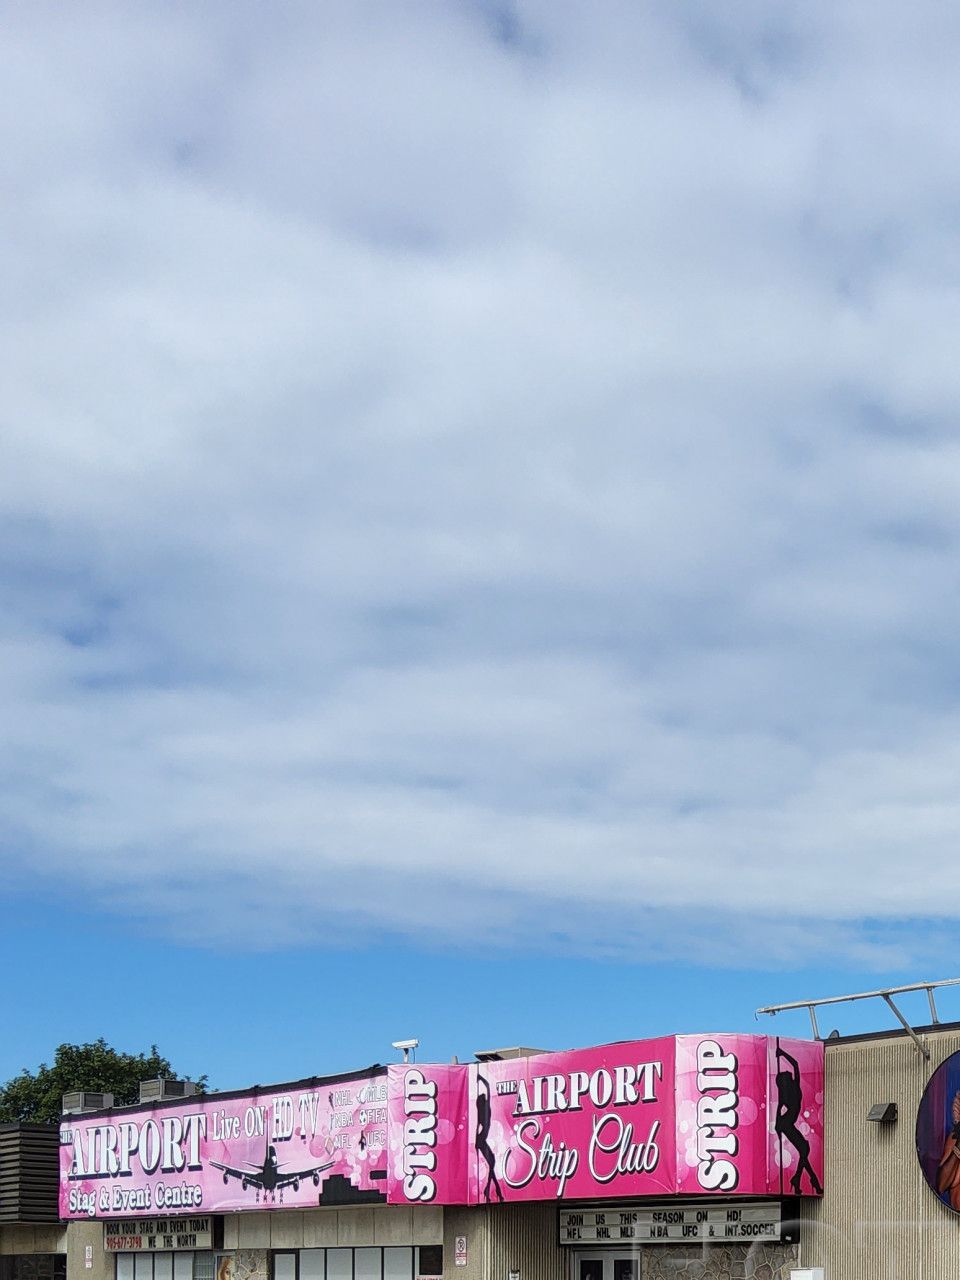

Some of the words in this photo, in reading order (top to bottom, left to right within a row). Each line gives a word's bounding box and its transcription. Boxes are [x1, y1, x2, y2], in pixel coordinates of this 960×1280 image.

[335, 1090, 353, 1107] NHL
[366, 1085, 387, 1103] MLB
[496, 1080, 517, 1096] THE
[512, 1061, 663, 1118] AIRPORT
[212, 1109, 240, 1141] Live
[244, 1105, 266, 1137] ON
[272, 1096, 295, 1142] HD
[299, 1092, 320, 1140] TV
[335, 1111, 354, 1128] NBA
[367, 1108, 387, 1124] FIFA
[696, 1040, 739, 1192] STRIP
[68, 1114, 207, 1180] AIRPORT
[334, 1133, 352, 1149] NFL
[367, 1130, 386, 1146] UFC
[403, 1069, 438, 1202] STRIP
[502, 1118, 579, 1198] Strip
[588, 1113, 661, 1185] Club
[69, 1188, 97, 1216] Stag
[100, 1186, 109, 1211] &
[112, 1184, 151, 1210] Event
[155, 1181, 202, 1208] Centre
[122, 1222, 137, 1234] YOUR
[140, 1222, 153, 1233] STAG
[157, 1221, 167, 1233] AND
[170, 1220, 187, 1232] EVENT
[189, 1219, 208, 1231] TODAY
[567, 1216, 584, 1226] JOIN
[596, 1215, 605, 1225] US
[620, 1213, 637, 1224] THIS
[652, 1212, 684, 1223] SEASON
[696, 1211, 708, 1223] ON
[727, 1210, 742, 1222] HD!
[567, 1228, 581, 1239] NFL
[596, 1227, 610, 1239] NHL
[620, 1226, 636, 1238] MLB
[651, 1226, 668, 1237] NBA
[682, 1225, 698, 1237] UFC
[708, 1225, 714, 1237] &
[148, 1235, 156, 1248] WE
[163, 1235, 173, 1247] THE
[177, 1234, 196, 1247] NORTH
